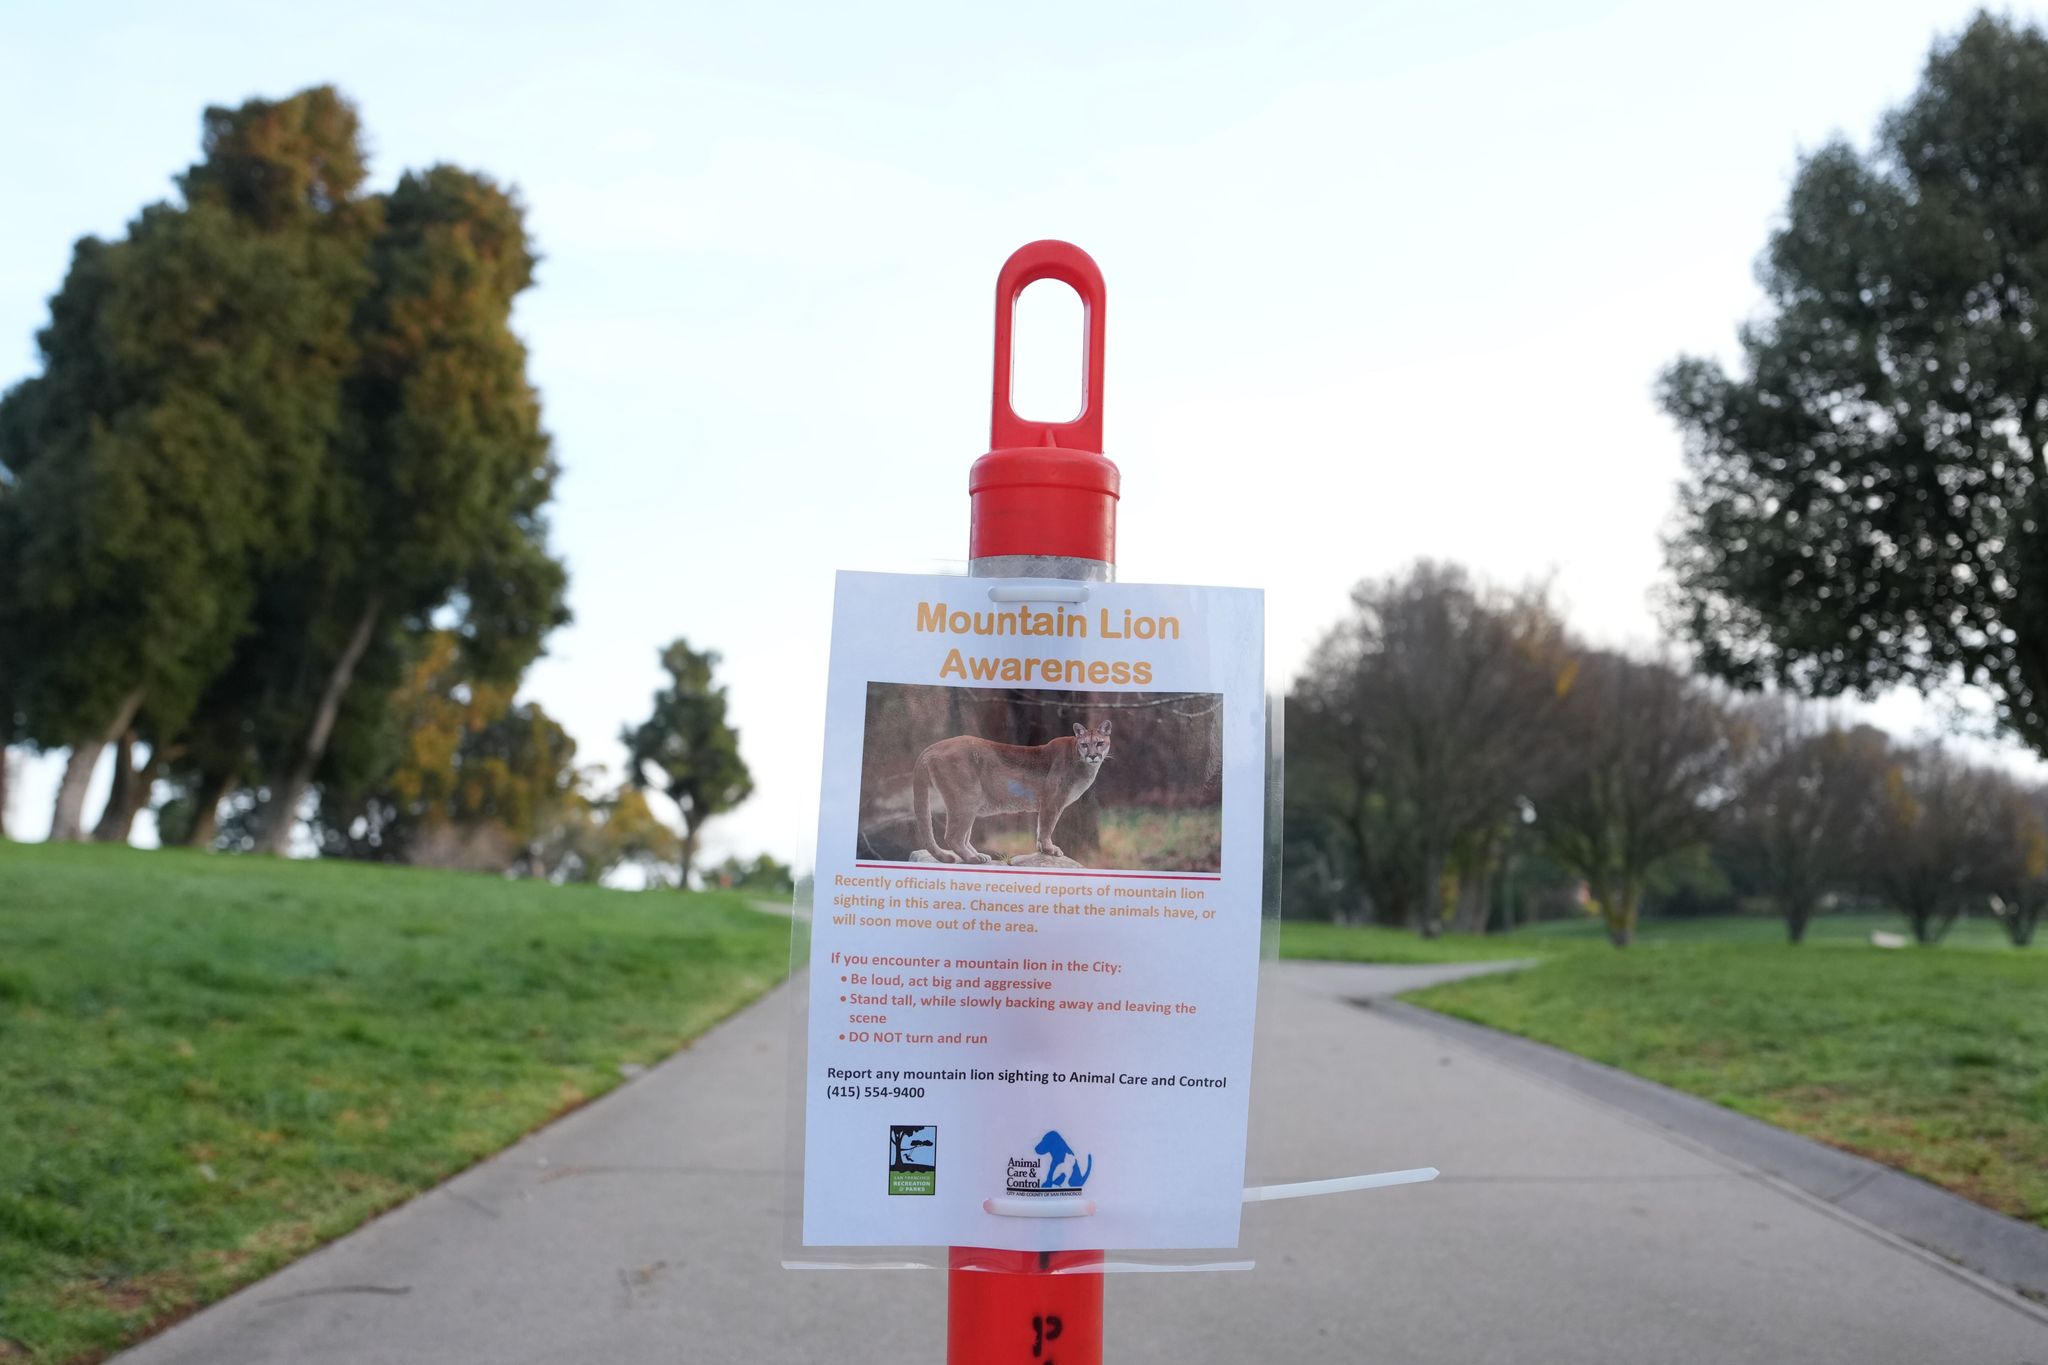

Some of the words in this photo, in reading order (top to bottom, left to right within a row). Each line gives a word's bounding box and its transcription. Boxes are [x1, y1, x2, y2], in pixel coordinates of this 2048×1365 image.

[916, 602, 1087, 638] Mountain
[1100, 608, 1180, 640] Lion
[939, 648, 1153, 685] Awareness
[834, 874, 892, 890] Recently
[894, 876, 946, 891] officials
[949, 879, 982, 892] have
[985, 881, 1041, 895] received
[1044, 885, 1093, 898] reports
[1096, 884, 1111, 897] of
[1113, 886, 1177, 899] mountain
[1180, 886, 1205, 900] lion
[833, 894, 885, 910] sighting
[888, 895, 902, 908] in
[904, 896, 929, 909] this
[932, 900, 966, 911] area.
[969, 898, 1024, 913] Chances
[1027, 904, 1049, 914] are
[1052, 901, 1080, 915] that
[1083, 903, 1106, 916] the
[1108, 904, 1160, 918] animals
[1163, 905, 1198, 920] have,
[1201, 910, 1216, 919] or
[832, 912, 856, 926] will
[859, 916, 892, 927] soon
[895, 918, 932, 929] move
[935, 919, 959, 930] out
[962, 918, 977, 931] of
[978, 919, 1002, 932] the
[1004, 922, 1038, 933] area.
[831, 951, 841, 964] If
[843, 955, 868, 968] you
[871, 956, 940, 968] encounter
[943, 959, 952, 968] a
[955, 958, 1019, 970] mountain
[1023, 958, 1047, 971] lion
[1050, 959, 1063, 971] in
[1066, 960, 1089, 972] the
[1092, 961, 1122, 976] City:
[850, 973, 868, 985] Be
[871, 973, 904, 990] loud,
[908, 976, 928, 987] act
[932, 975, 952, 991] big
[955, 976, 980, 988] and
[983, 978, 1052, 992] aggressive
[849, 993, 888, 1005] Stand
[890, 994, 916, 1008] tall,
[920, 994, 956, 1007] while
[960, 995, 1002, 1010] slowly
[1005, 996, 1056, 1011] backing
[1058, 1000, 1094, 1012] away
[1096, 999, 1122, 1011] and
[1124, 1000, 1172, 1016] leaving
[1174, 1002, 1196, 1014] the
[849, 1014, 887, 1024] scene
[848, 1031, 870, 1043] DO
[873, 1031, 903, 1044] NOT
[905, 1032, 934, 1043] turn
[936, 1032, 962, 1044] and
[965, 1035, 988, 1044] run
[827, 1067, 872, 1081] Report
[875, 1070, 900, 1082] any
[903, 1068, 966, 1080] mountain
[970, 1068, 994, 1080] lion
[998, 1069, 1049, 1085] sighting
[1052, 1071, 1066, 1082] to
[1069, 1071, 1115, 1084] Animal
[1118, 1073, 1148, 1085] Care
[1151, 1075, 1176, 1086] and
[1179, 1075, 1226, 1088] Control
[826, 1085, 860, 1100] (415)
[864, 1086, 925, 1098] 554-9400
[1007, 1167, 1028, 1177] Care
[1029, 1168, 1037, 1177] &
[1008, 1157, 1040, 1168] Animal
[1007, 1178, 1040, 1188] Control
